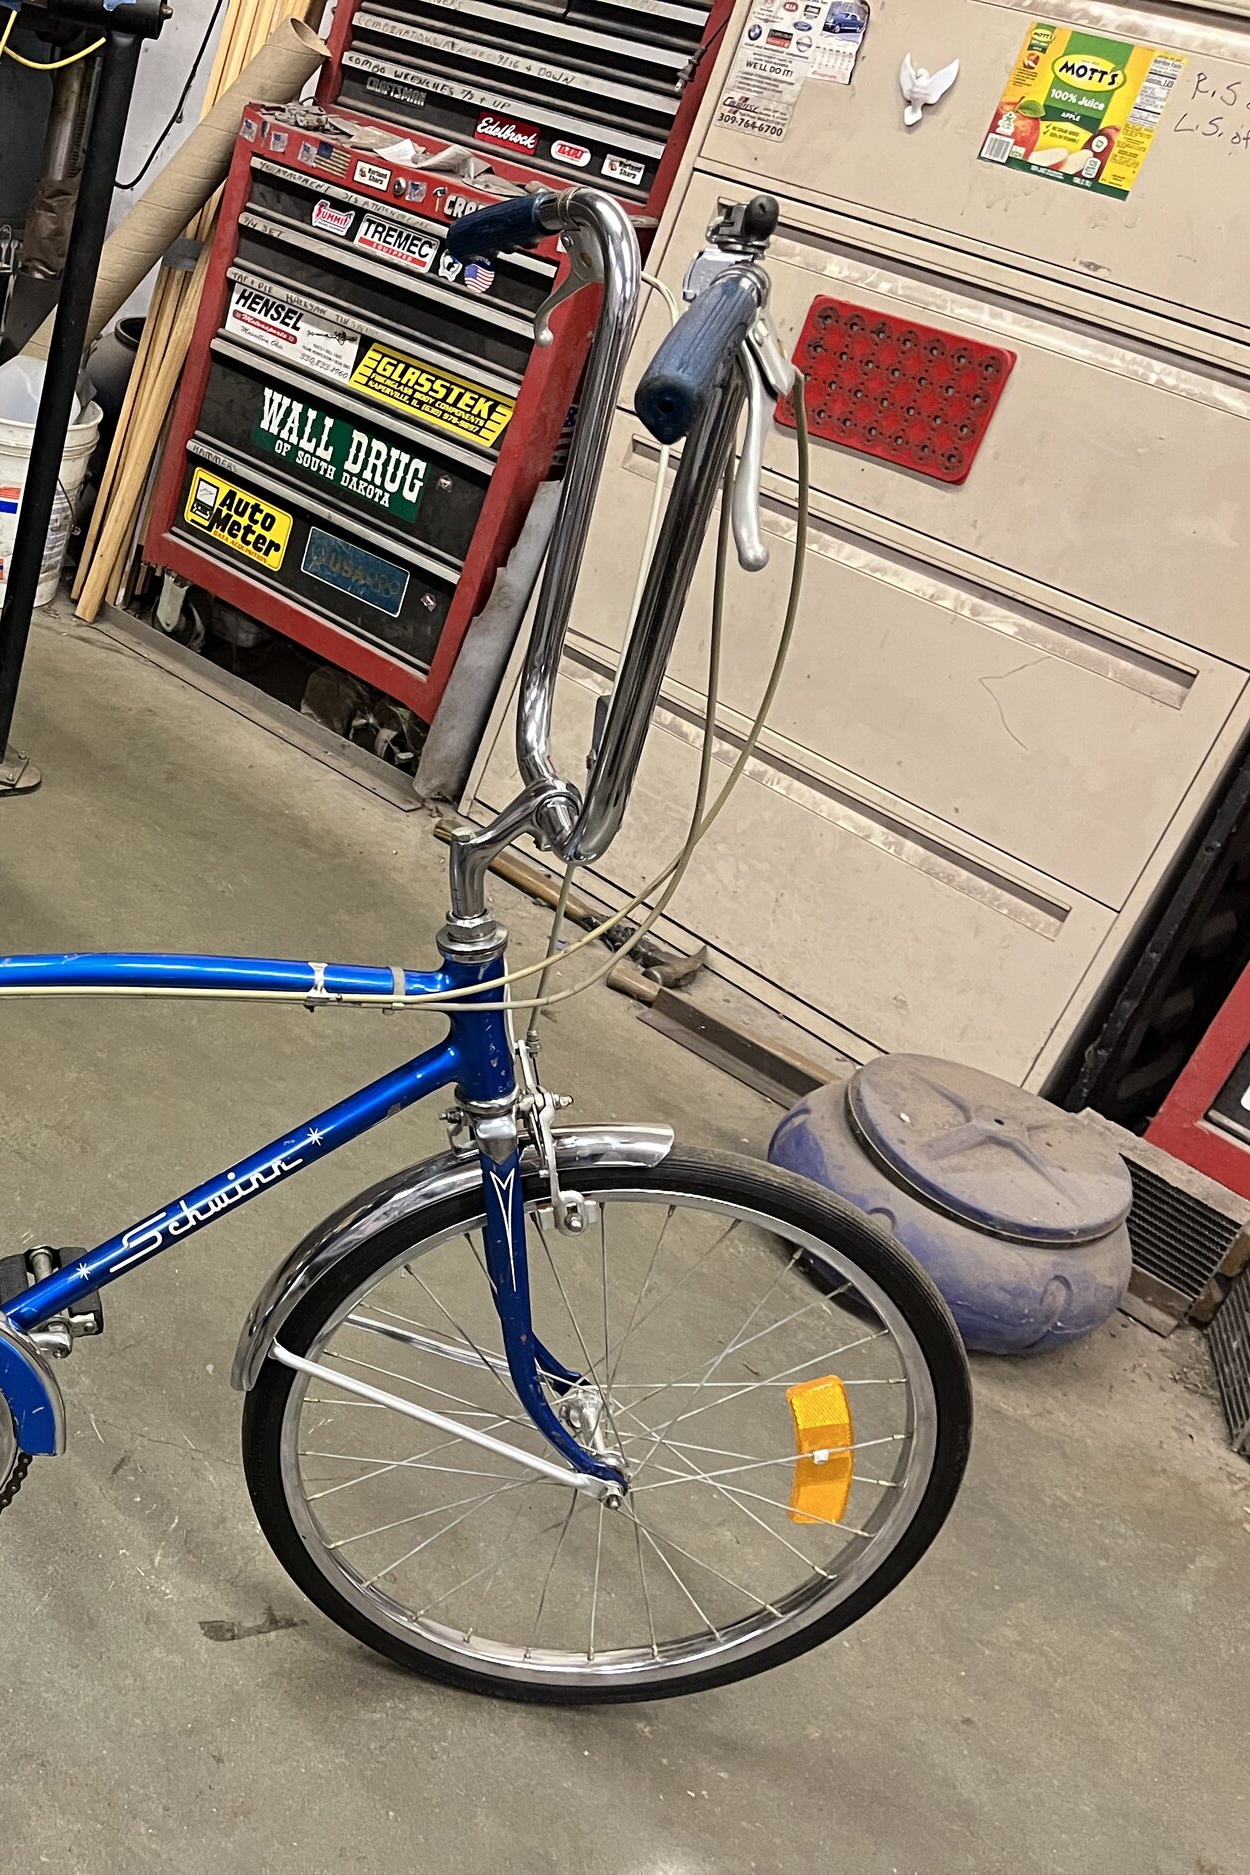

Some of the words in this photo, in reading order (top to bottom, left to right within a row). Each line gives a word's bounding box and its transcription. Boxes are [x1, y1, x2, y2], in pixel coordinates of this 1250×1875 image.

[348, 55, 386, 74] COMBO
[492, 99, 511, 110] UP
[537, 67, 576, 85] DOWN
[769, 65, 781, 75] DO
[1058, 59, 1119, 87] MOTT'S
[366, 77, 426, 106] CRAFTSMAN
[1050, 87, 1077, 104] 100%
[477, 116, 537, 149] Edelbrock
[1060, 111, 1081, 122] APPLE
[364, 218, 432, 258] TREMEC
[372, 242, 412, 262] EQUIPPED
[235, 288, 304, 332] HENSEL
[370, 373, 414, 396] FIBERGLASS
[413, 391, 436, 404] BODY
[435, 401, 485, 427] COMPONENTS
[376, 354, 494, 420] GLASSTEK
[259, 386, 335, 462] WALL
[343, 428, 428, 504] DRUG
[275, 439, 292, 457] OF
[295, 450, 337, 480] SOUTH
[340, 472, 391, 508] DAKOTA
[218, 488, 277, 533] Auto
[207, 507, 281, 558] Meter
[109, 1158, 303, 1273] Schwinn
